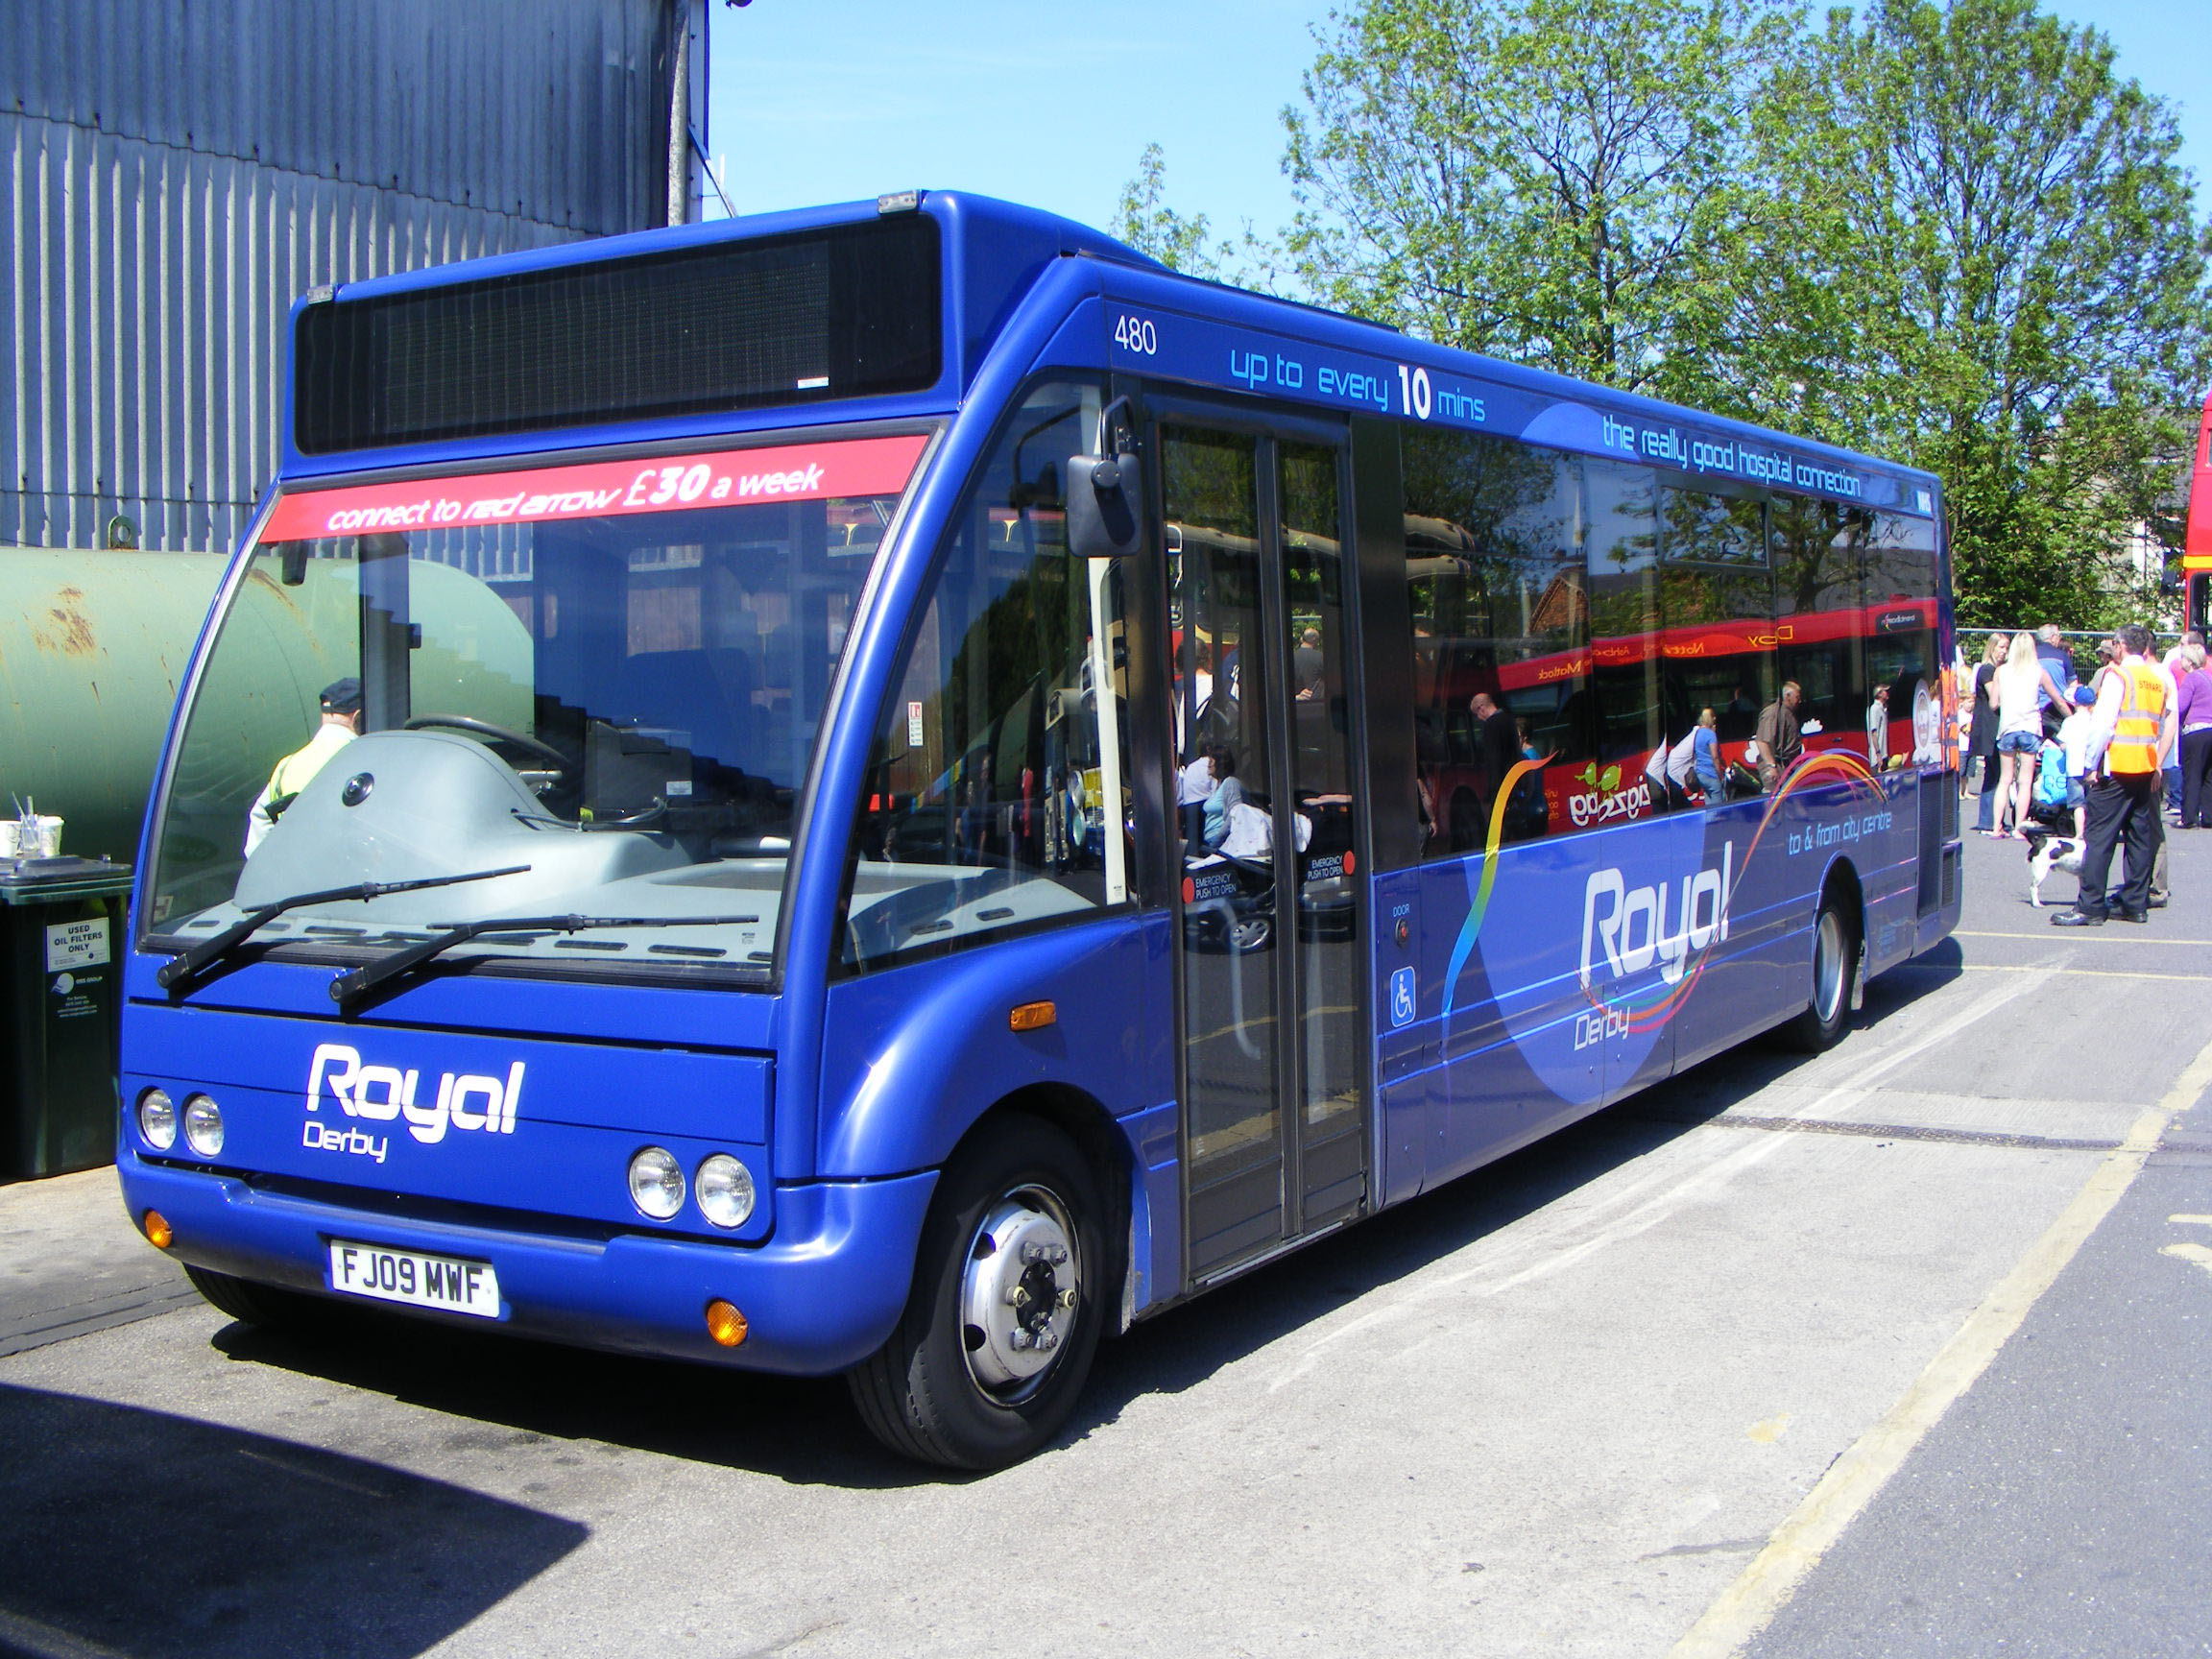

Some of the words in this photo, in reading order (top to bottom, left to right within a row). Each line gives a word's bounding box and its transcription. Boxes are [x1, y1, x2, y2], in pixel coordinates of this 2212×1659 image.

[1115, 315, 1157, 355] 480
[1231, 349, 1268, 389] up
[1277, 353, 1303, 388] to
[1319, 366, 1388, 412] every
[1398, 365, 1431, 421] 10
[1439, 388, 1485, 422] mins
[1603, 414, 1634, 450] the
[1641, 428, 1687, 469] really
[1693, 441, 1733, 473] good
[1739, 444, 1792, 484] hospital
[1797, 463, 1861, 497] connection
[326, 503, 429, 531] connect
[433, 499, 459, 522] to
[462, 494, 518, 521] red
[519, 490, 622, 517] arrow
[622, 463, 711, 507] £30
[709, 478, 733, 499] a
[738, 463, 825, 494] week
[1789, 832, 1801, 855] to
[1804, 826, 1813, 852] &
[1816, 823, 1841, 848] from
[1842, 815, 1861, 843] city
[1863, 810, 1892, 835] centre
[1195, 873, 1232, 889] EMERGENCY
[1308, 869, 1322, 879] PUSH
[1323, 867, 1330, 878] TO
[1329, 865, 1344, 877] OPEN
[1311, 854, 1343, 869] EMERGENCY
[1195, 886, 1211, 900] PUSH
[1212, 885, 1219, 897] TO
[1219, 883, 1237, 896] OPEN
[1392, 903, 1410, 917] DOOR
[68, 925, 90, 935] USED
[1582, 842, 1732, 987] Royal
[54, 938, 68, 947] OIL
[70, 931, 103, 944] FILTERS
[68, 943, 90, 953] ONLY
[1575, 1004, 1630, 1051] Derby
[306, 1043, 526, 1143] Royal
[302, 1120, 388, 1164] Derby
[342, 1248, 416, 1294] FJ09
[424, 1261, 483, 1304] MWF
